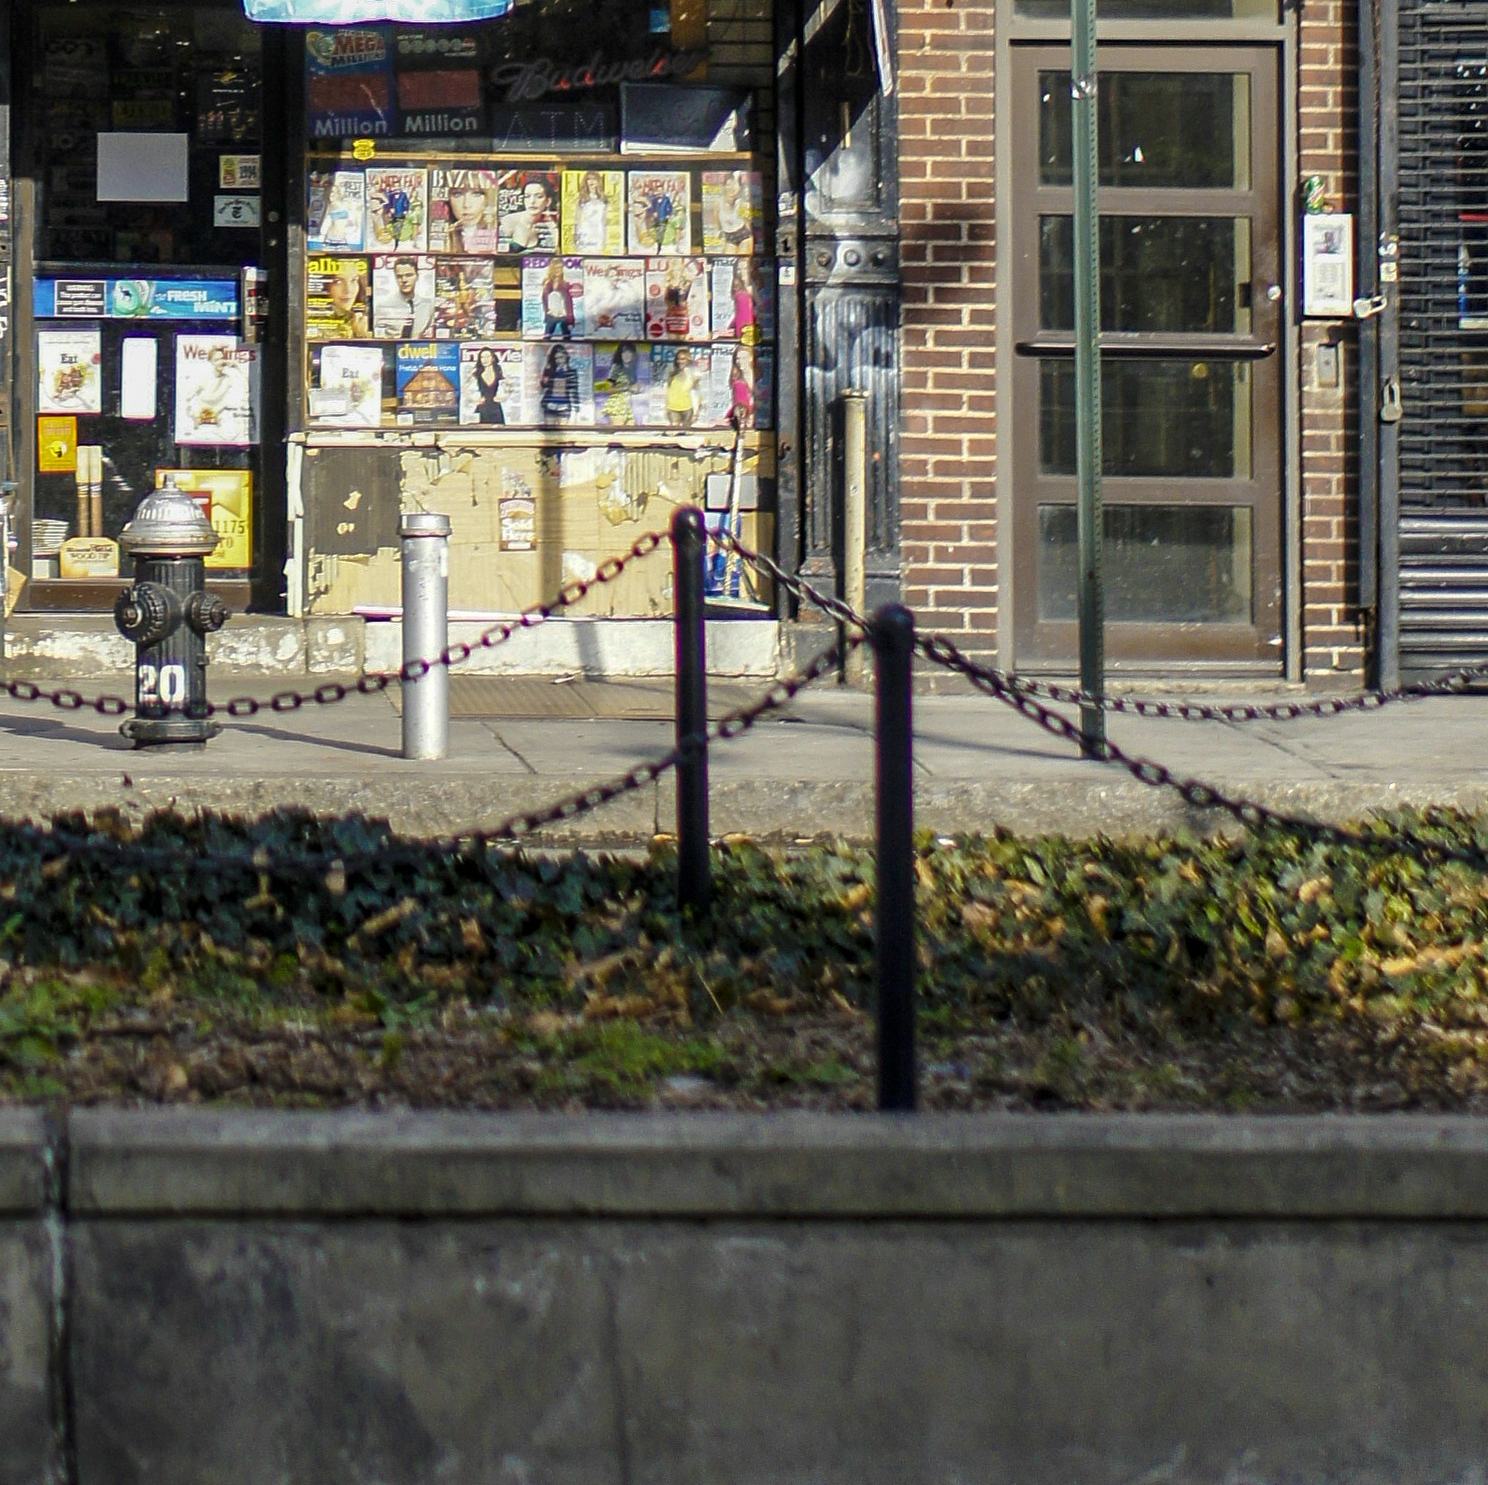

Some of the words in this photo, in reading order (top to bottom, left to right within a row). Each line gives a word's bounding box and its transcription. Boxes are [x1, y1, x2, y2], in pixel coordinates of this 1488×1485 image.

[333, 32, 386, 57] MEGA
[314, 116, 388, 136] Million
[404, 114, 478, 133] Million
[501, 111, 605, 149] ATM
[167, 290, 208, 302] FRESH
[59, 353, 79, 365] Eat
[397, 343, 439, 360] dwell
[139, 664, 185, 705] 20
